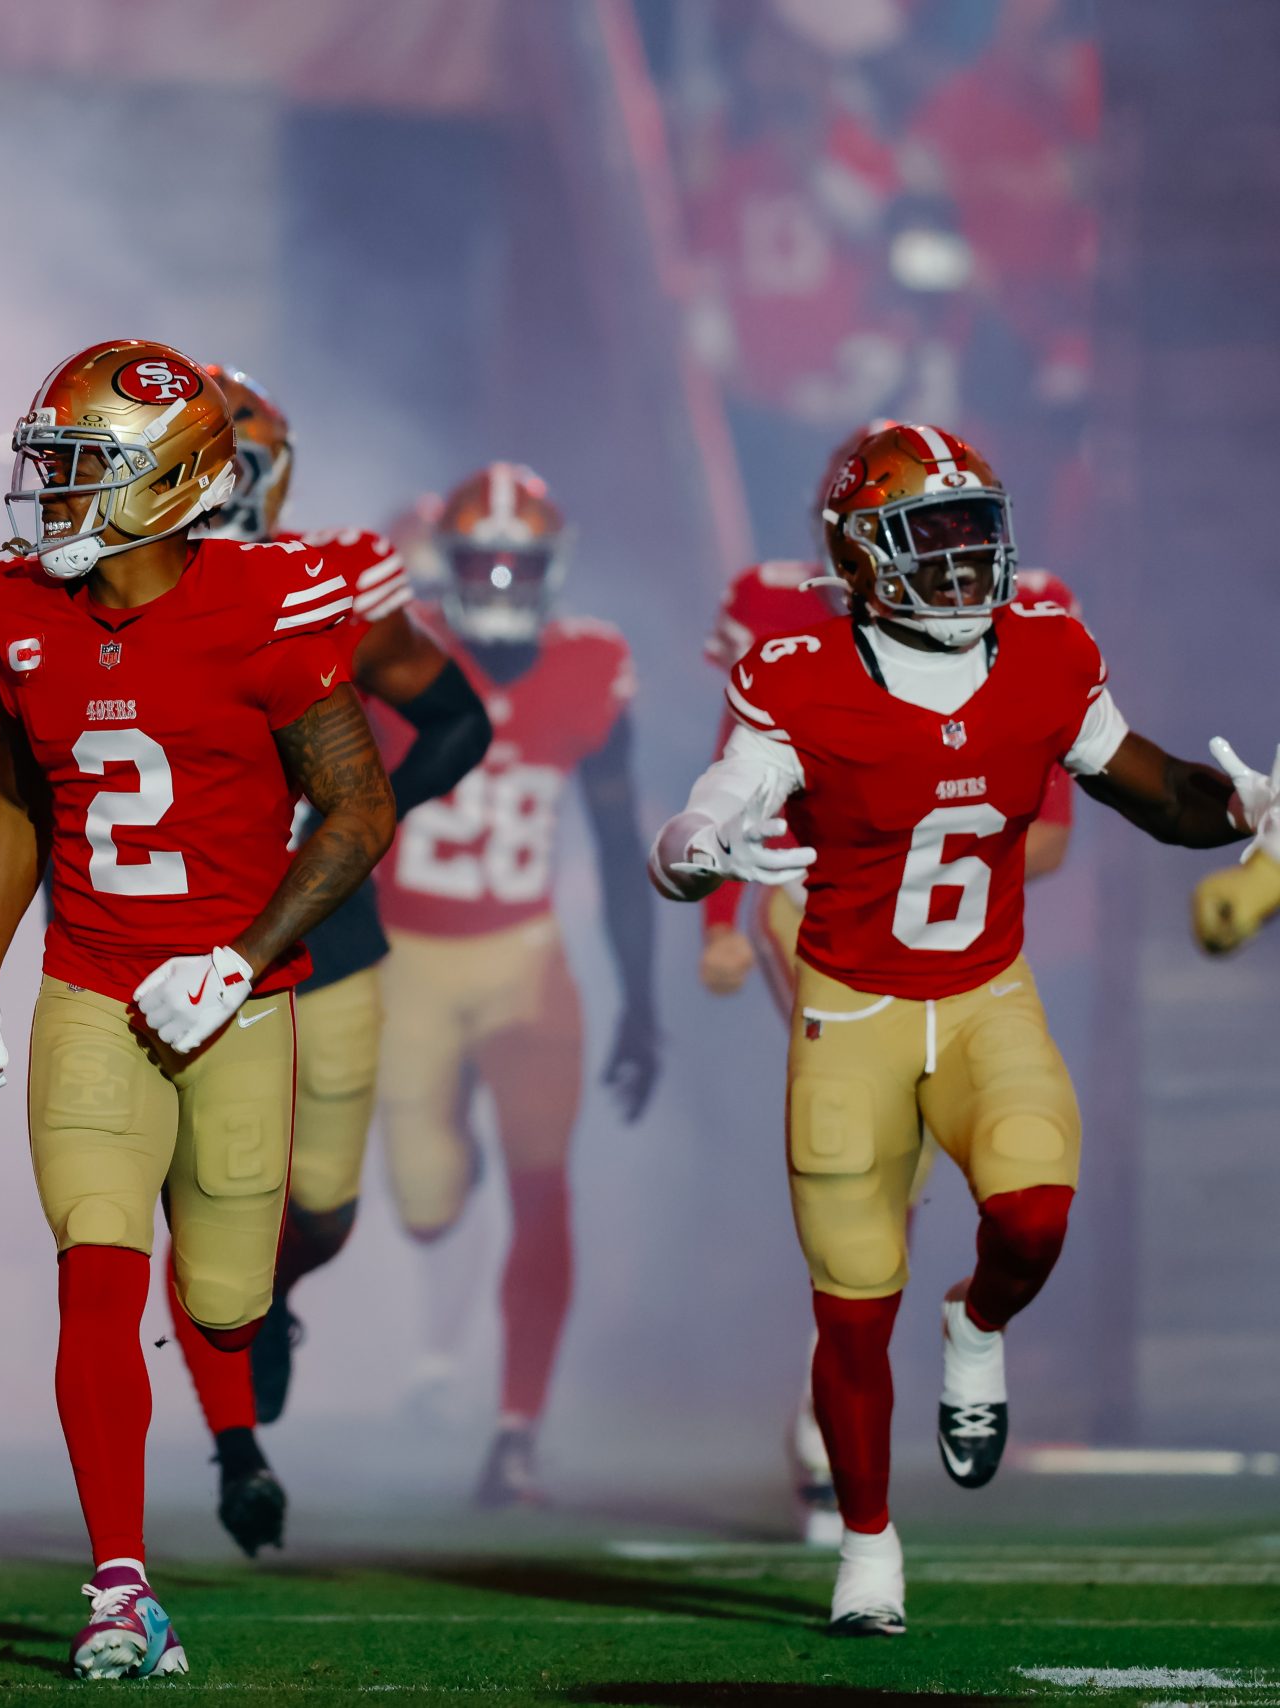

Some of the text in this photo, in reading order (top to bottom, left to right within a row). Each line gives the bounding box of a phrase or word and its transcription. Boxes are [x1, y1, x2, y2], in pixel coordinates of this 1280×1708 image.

[136, 362, 190, 398] SF
[8, 638, 41, 672] C
[760, 635, 821, 663] 6
[86, 699, 137, 720] 49ERS
[71, 728, 188, 894] 2
[394, 765, 562, 904] 28
[892, 803, 1006, 951] 6
